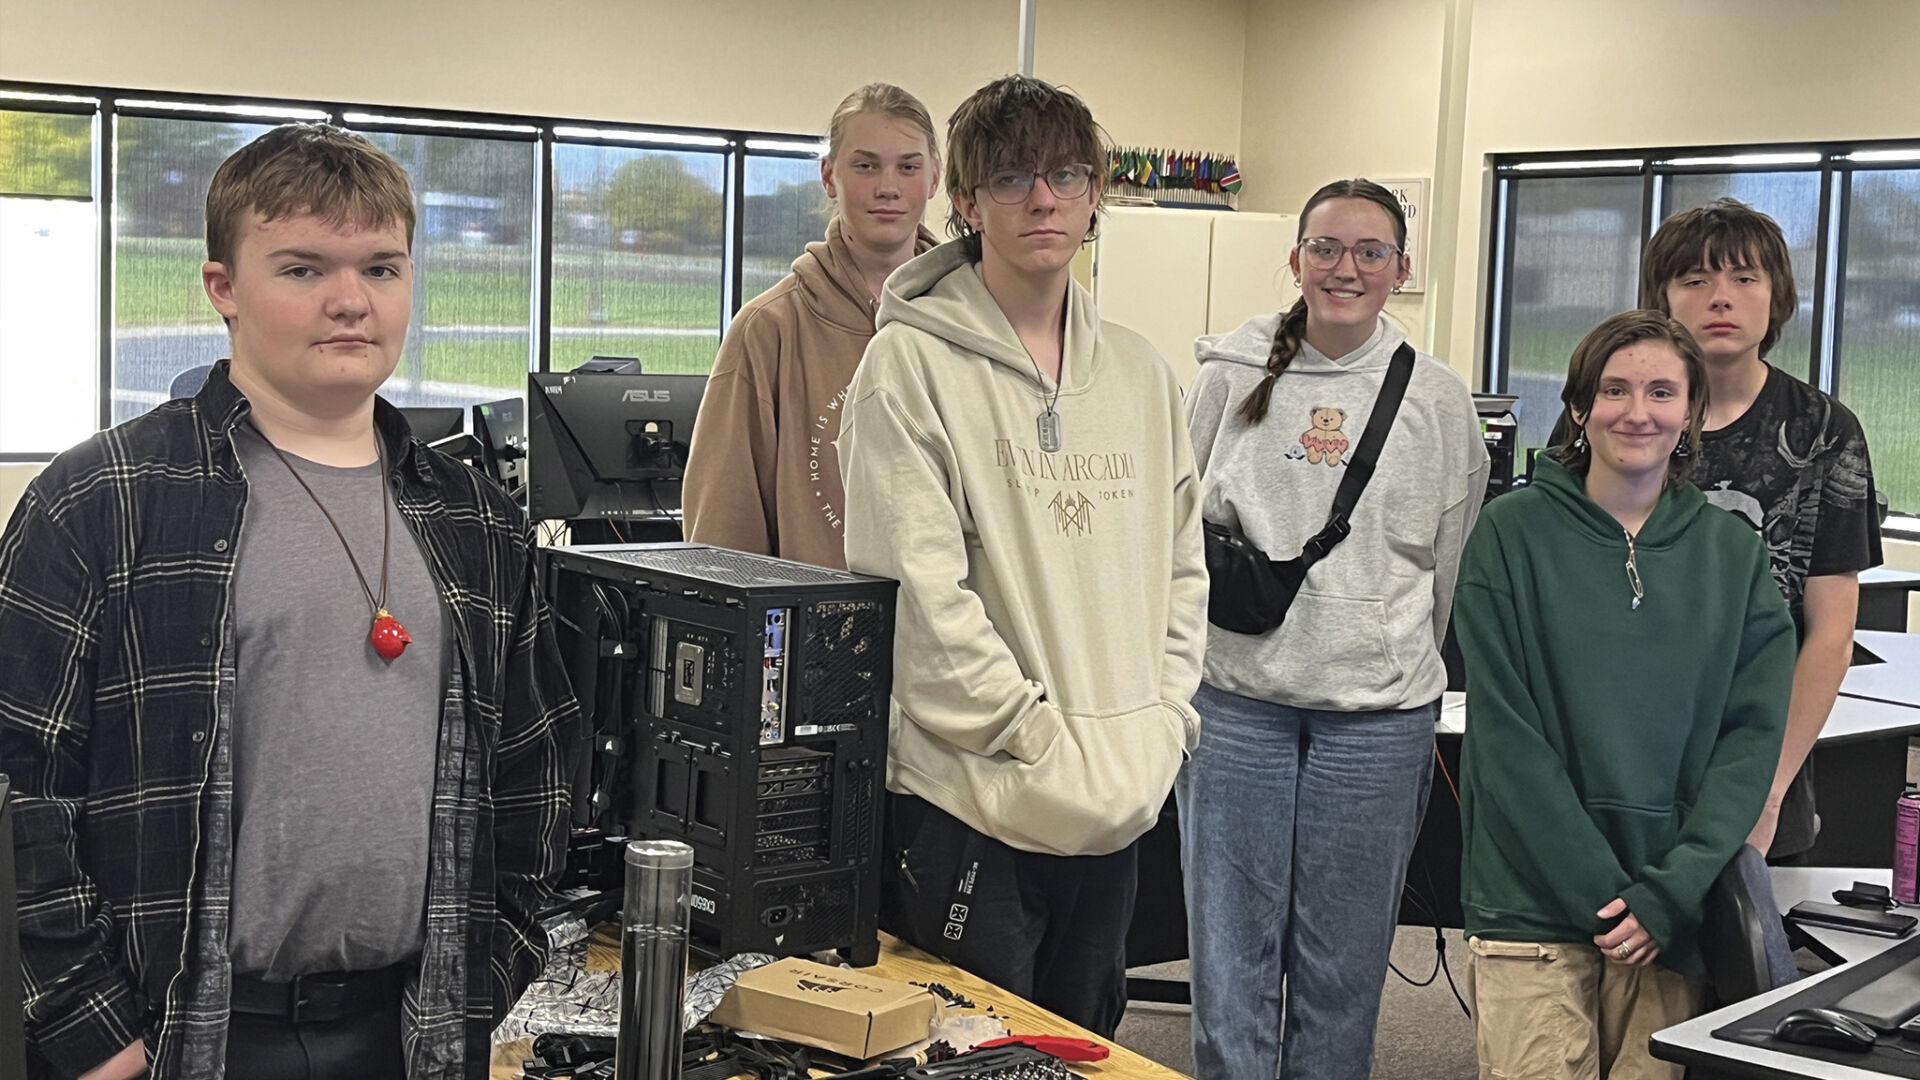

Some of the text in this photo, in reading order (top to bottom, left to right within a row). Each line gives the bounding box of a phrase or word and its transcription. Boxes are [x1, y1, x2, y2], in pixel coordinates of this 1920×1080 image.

[621, 389, 671, 402] ASUS
[809, 385, 850, 481] HOME IS WH
[1006, 478, 1040, 497] SLP
[821, 503, 842, 529] THE
[788, 968, 884, 993] CORSAIR
